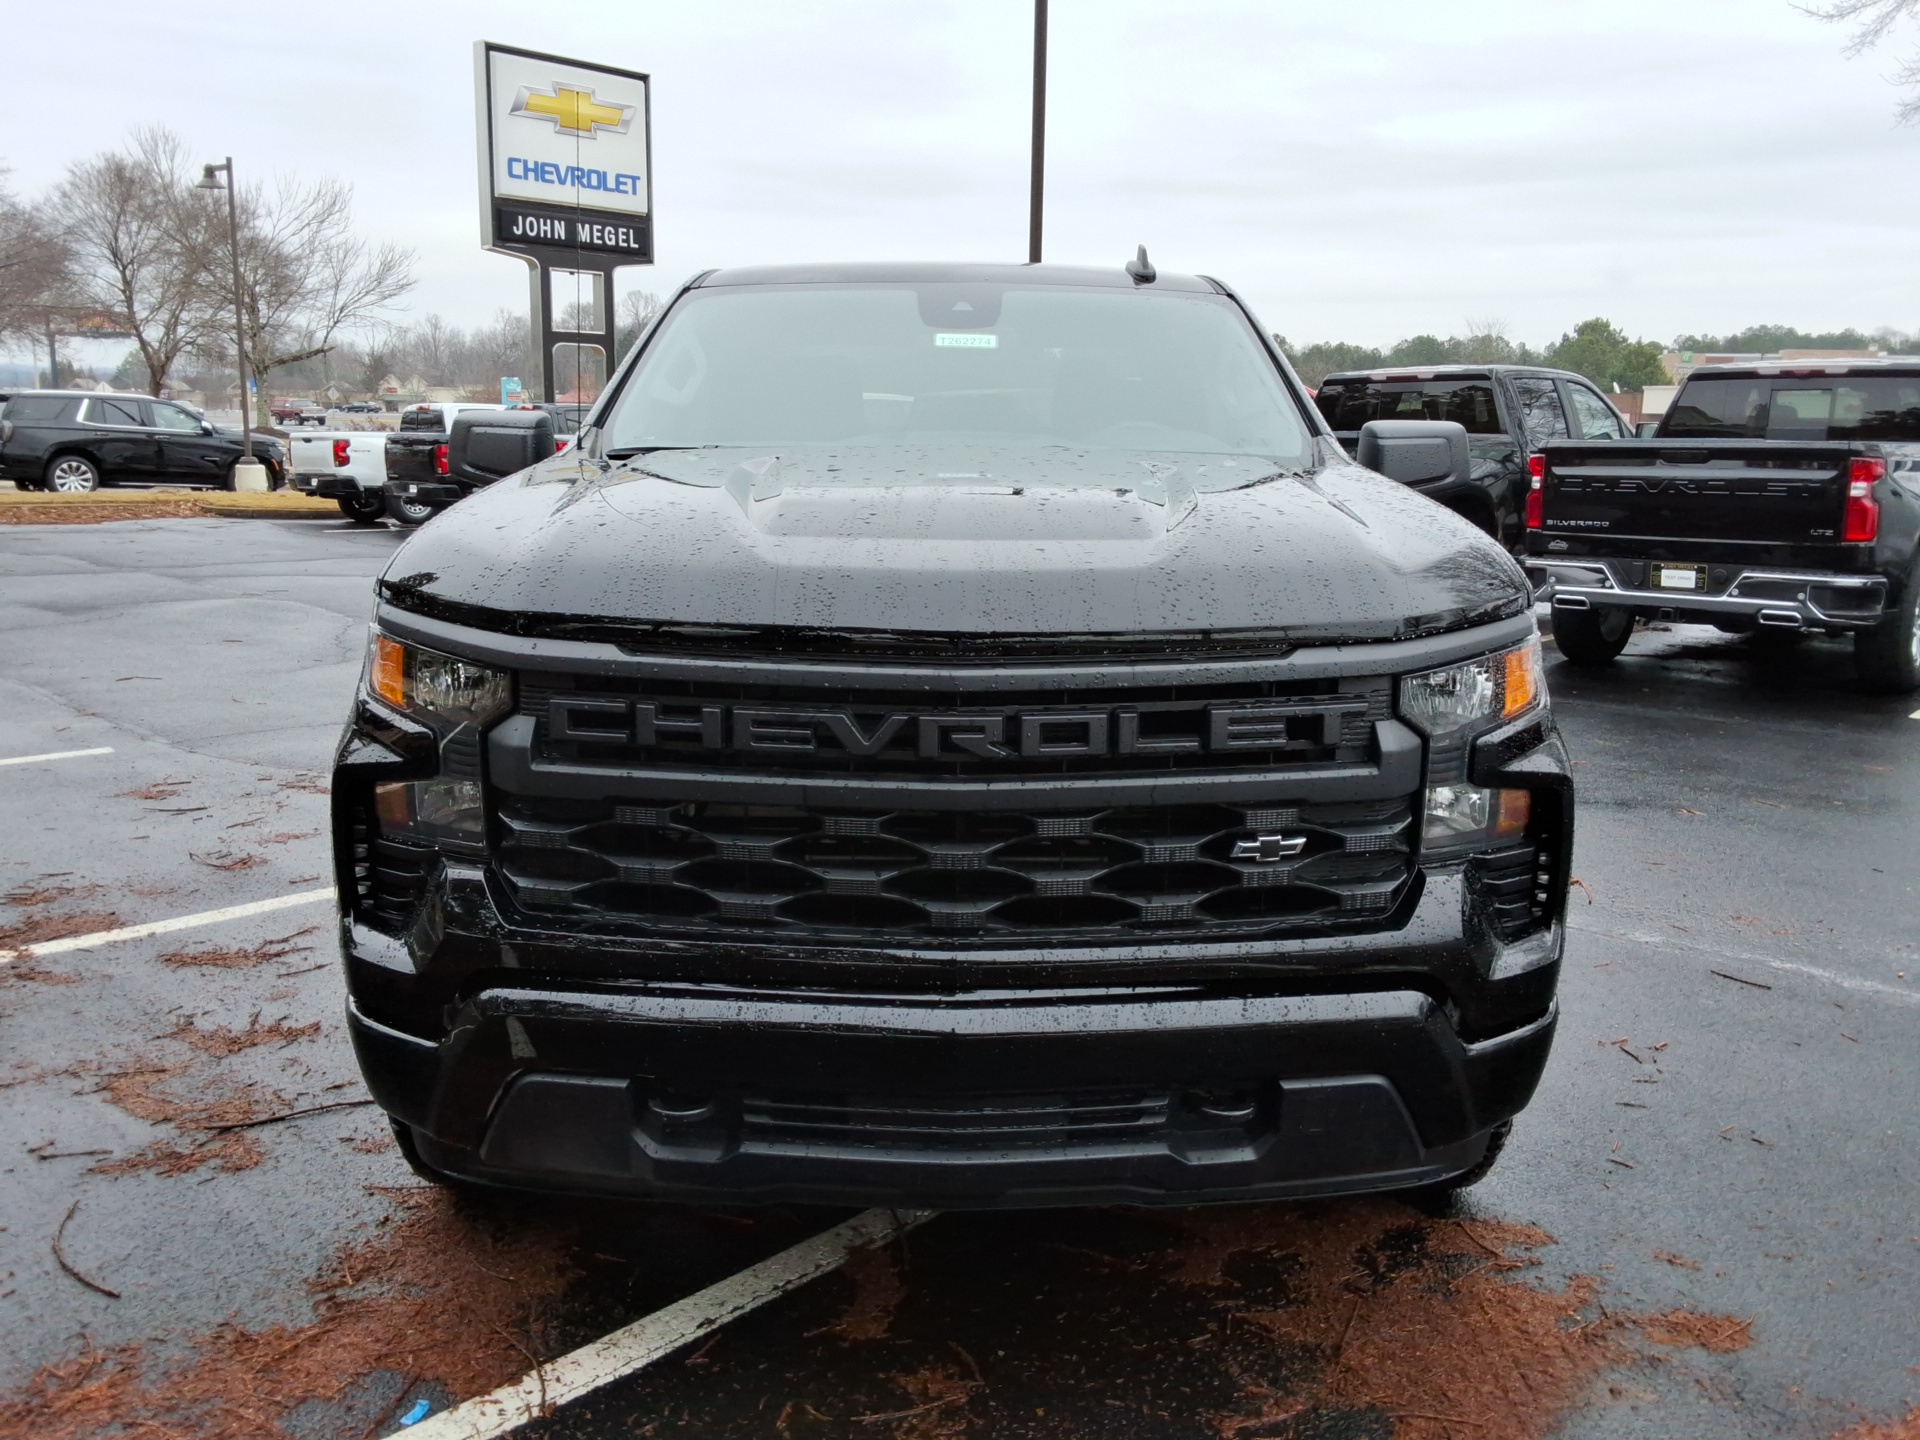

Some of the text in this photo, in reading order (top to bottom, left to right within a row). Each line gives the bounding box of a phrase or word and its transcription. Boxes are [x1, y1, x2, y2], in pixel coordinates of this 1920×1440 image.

[507, 157, 641, 195] CHEVROLET
[513, 215, 639, 249] JOHN MEGEL
[940, 337, 992, 346] T262274
[1560, 478, 1821, 497] CHEVROLET
[1546, 519, 1610, 527] SILVERADO
[549, 698, 1369, 758] CHEVROLET
